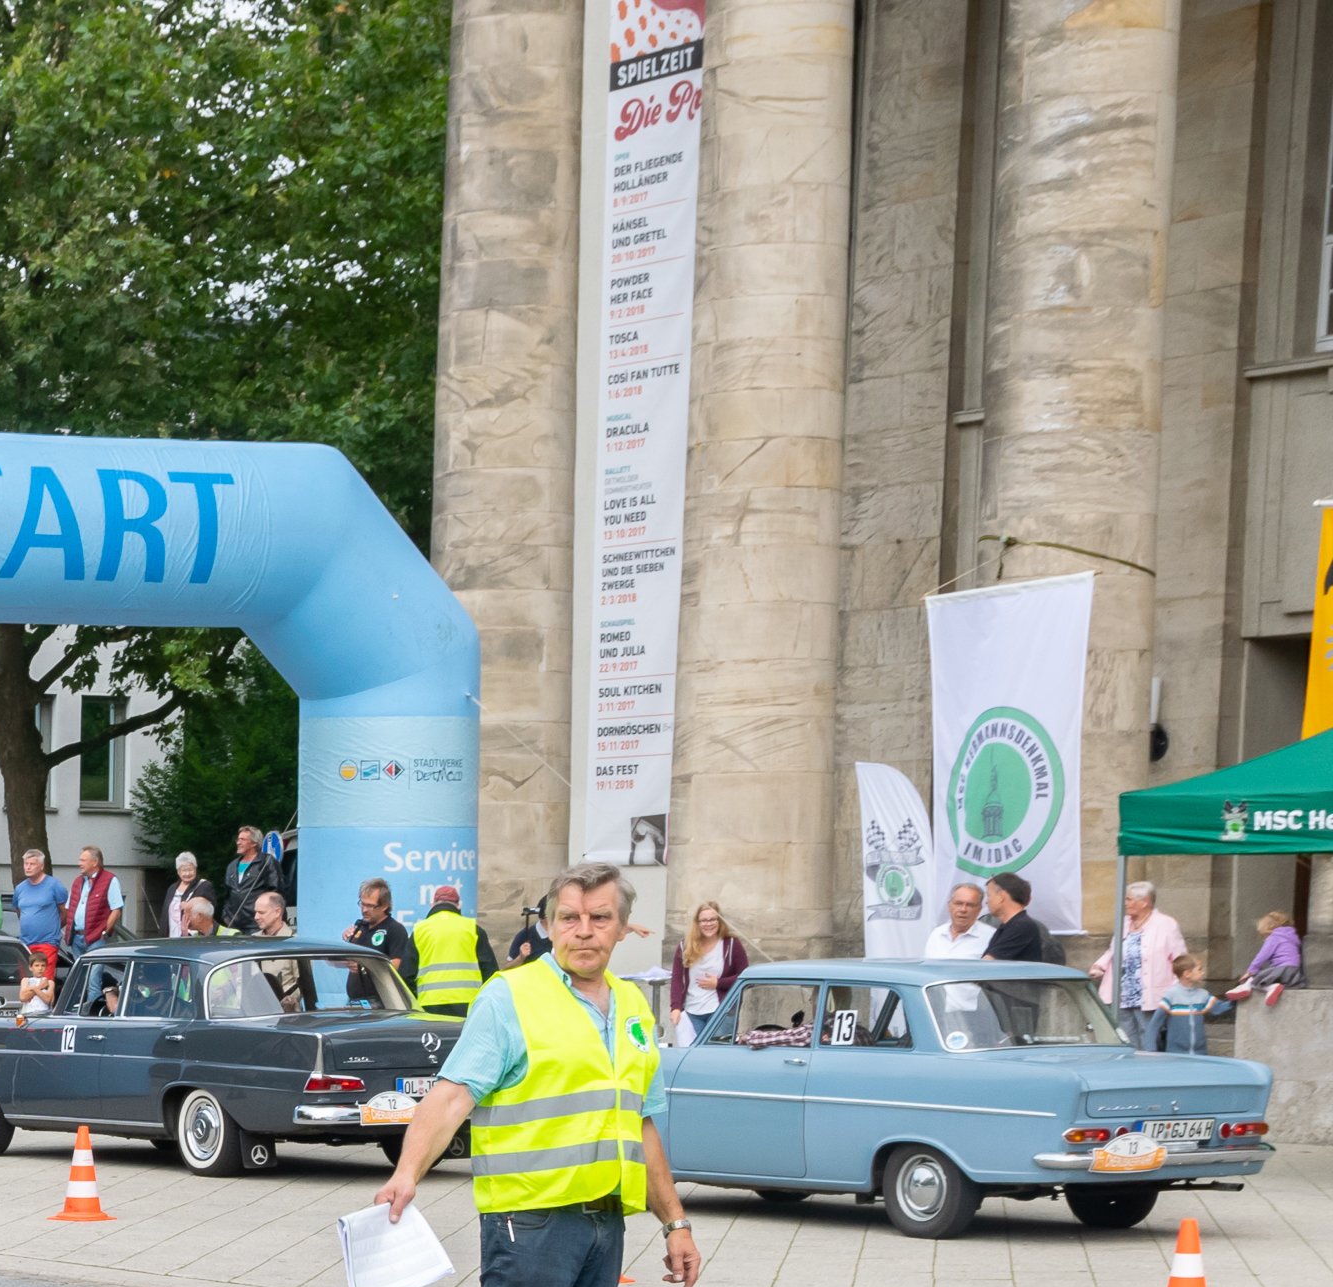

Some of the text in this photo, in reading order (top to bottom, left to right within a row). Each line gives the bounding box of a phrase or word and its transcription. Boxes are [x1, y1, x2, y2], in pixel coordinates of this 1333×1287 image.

[617, 46, 695, 87] SPIELZEIT
[614, 94, 662, 141] Die
[614, 151, 683, 177] DER FLIEGENDE
[613, 171, 669, 193] HOLLÄNDER
[613, 191, 648, 208] 8/9/2017
[612, 216, 649, 234] HÄNSEL
[612, 228, 667, 250] UND GRETEL
[611, 246, 656, 264] 20/10/2017
[610, 272, 650, 290] POWDER
[610, 287, 653, 306] HER FACE
[610, 304, 645, 320] 9/2/2018
[609, 330, 639, 345] TOSCA
[609, 344, 648, 360] 13/4/2018
[630, 369, 649, 382] FAN
[651, 363, 680, 378] TUTTE
[608, 385, 642, 400] 1/6/2018
[606, 412, 632, 422] MUSICAL
[606, 422, 650, 439] DRACULA
[606, 437, 646, 453] 1/12/2017
[604, 465, 631, 476] BALLETT
[603, 493, 656, 511] LOVE IS ALL
[603, 510, 647, 526] YOU NEED
[603, 526, 646, 540] 13/10/2017
[602, 546, 676, 564] SCHNEEWITTCHEN
[602, 562, 665, 578] UND DIE SIEBEN
[601, 578, 635, 592] ZWERGE
[601, 593, 637, 606] 2/3/2018
[600, 618, 636, 629] SCHAUSPIEL
[600, 630, 631, 644] ROMEO
[599, 645, 646, 659] UND JULIA
[599, 660, 638, 673] 22/9/2017
[598, 683, 662, 698] SOUL KITCHEN
[598, 700, 635, 713] 3/11/2017
[597, 723, 661, 738] DORNRÖSCHEN
[597, 739, 640, 752] 15/11/2017
[413, 758, 463, 768] STADTWERKE
[596, 764, 639, 777] DAS FEST
[596, 779, 634, 791] 19/1/2018
[1253, 810, 1303, 831] MSC
[383, 841, 476, 872] Service
[963, 842, 983, 862] IM
[835, 1012, 855, 1042] 13
[63, 1027, 75, 1051] 12
[404, 1081, 418, 1095] OL
[388, 1098, 398, 1110] 12
[1143, 1121, 1164, 1139] LIP
[1128, 1142, 1139, 1155] 13
